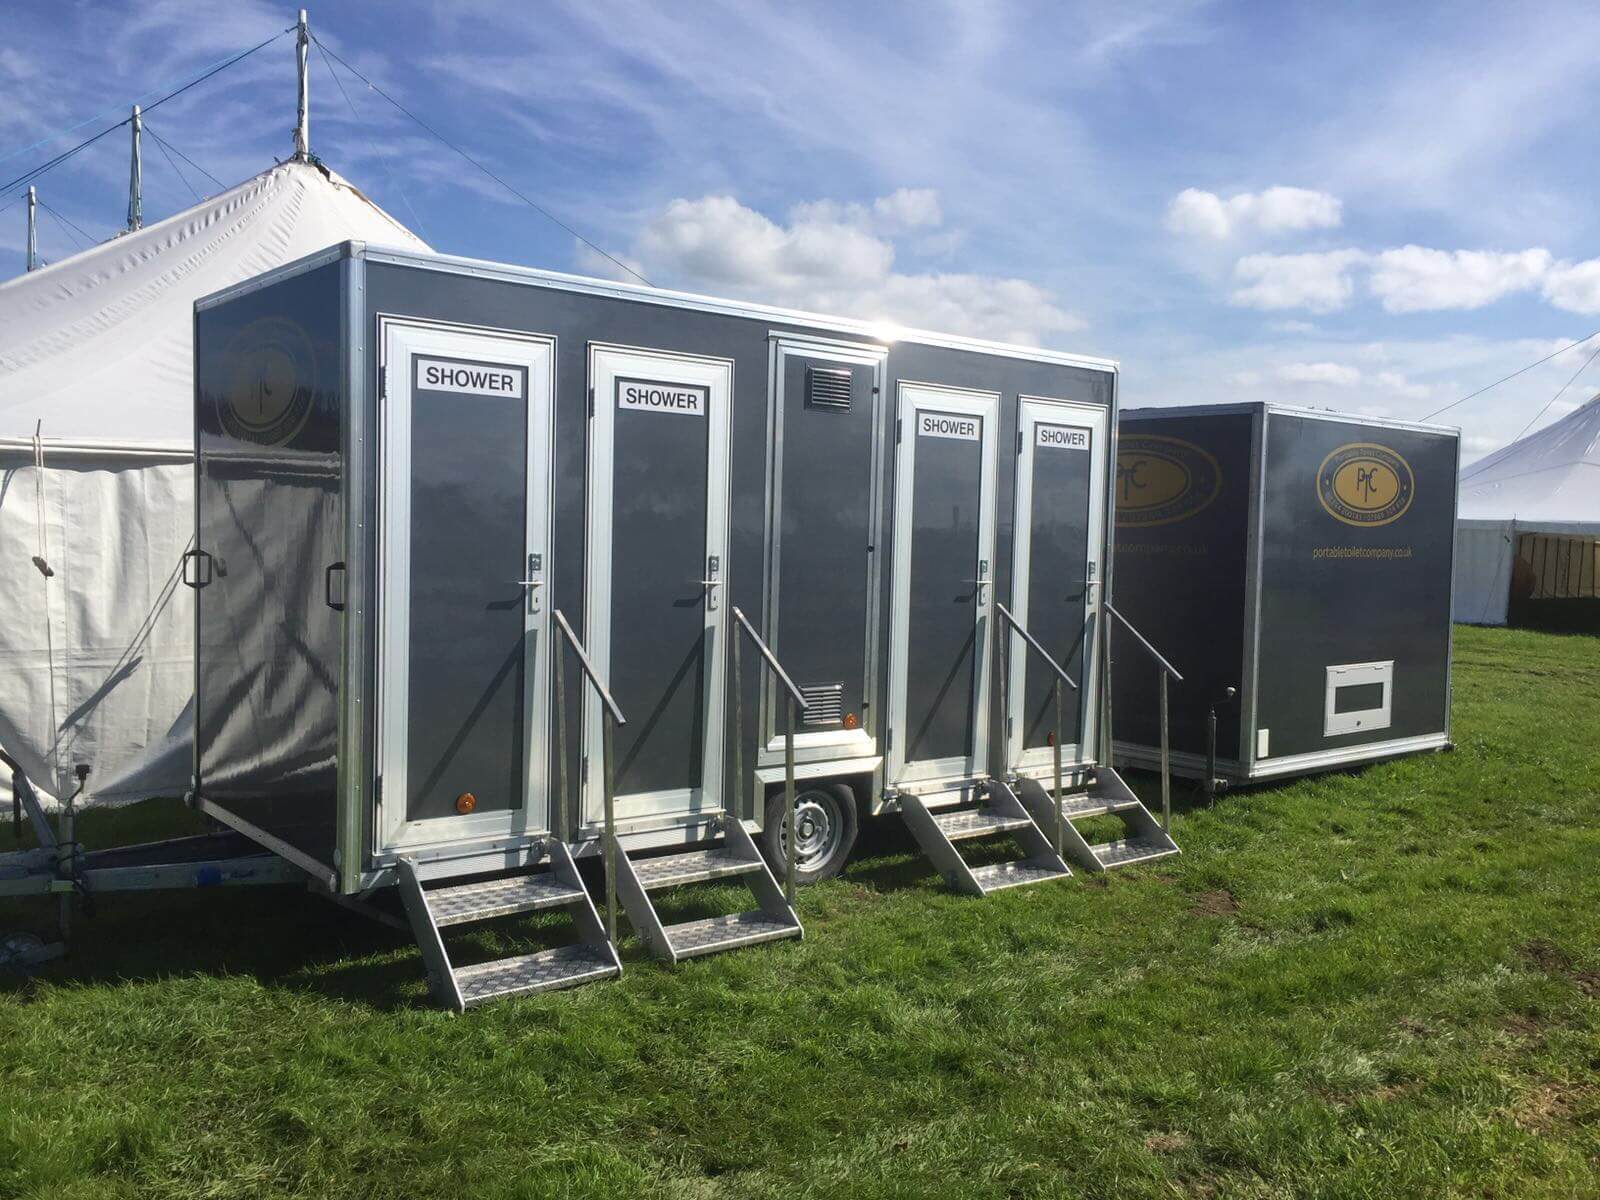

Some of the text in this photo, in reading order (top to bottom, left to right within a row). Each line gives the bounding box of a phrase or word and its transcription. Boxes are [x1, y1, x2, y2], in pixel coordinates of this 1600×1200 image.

[426, 366, 514, 392] SHOWER
[625, 388, 698, 410] SHOWER
[923, 418, 975, 436] SHOWER
[1040, 430, 1086, 446] SHOWER
